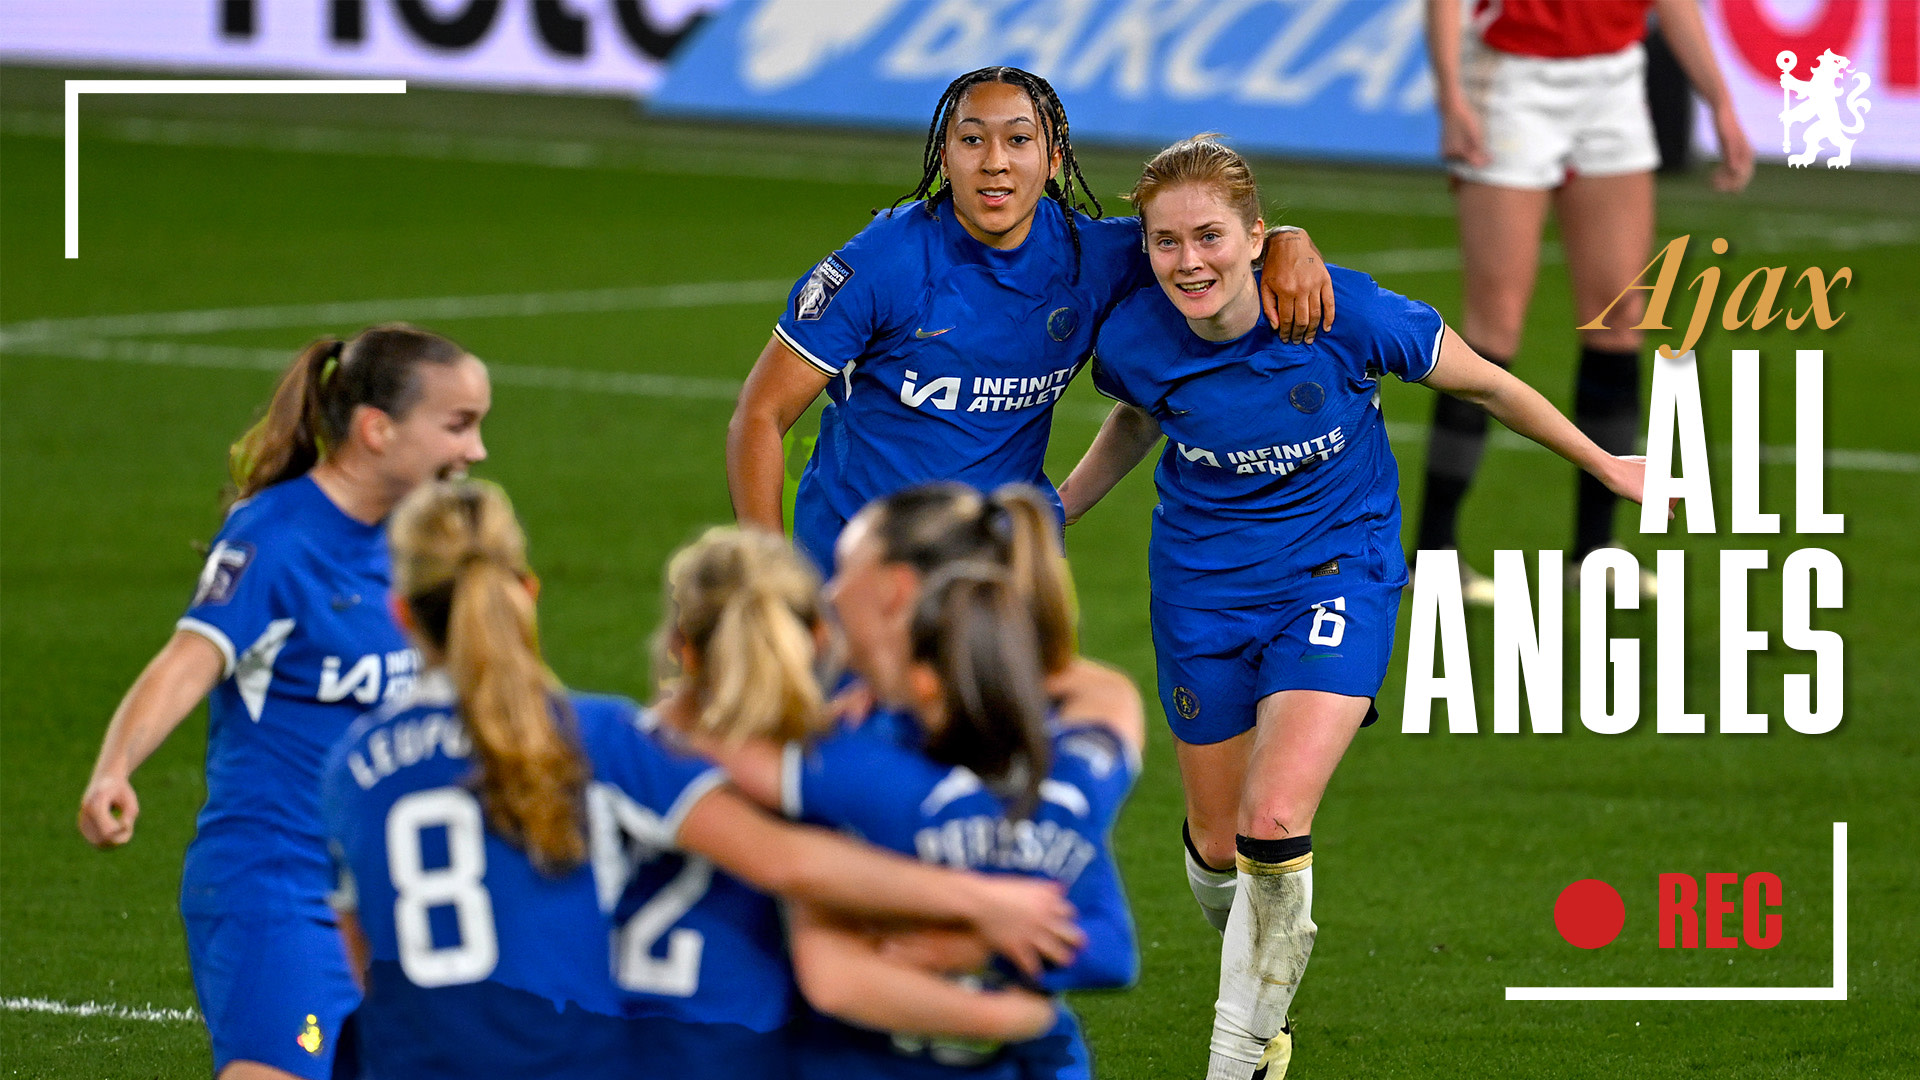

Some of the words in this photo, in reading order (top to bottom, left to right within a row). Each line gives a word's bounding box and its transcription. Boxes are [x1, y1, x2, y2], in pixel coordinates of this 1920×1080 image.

[1226, 426, 1345, 464] INFINITE
[1308, 596, 1346, 647] 6
[385, 786, 499, 989] 8
